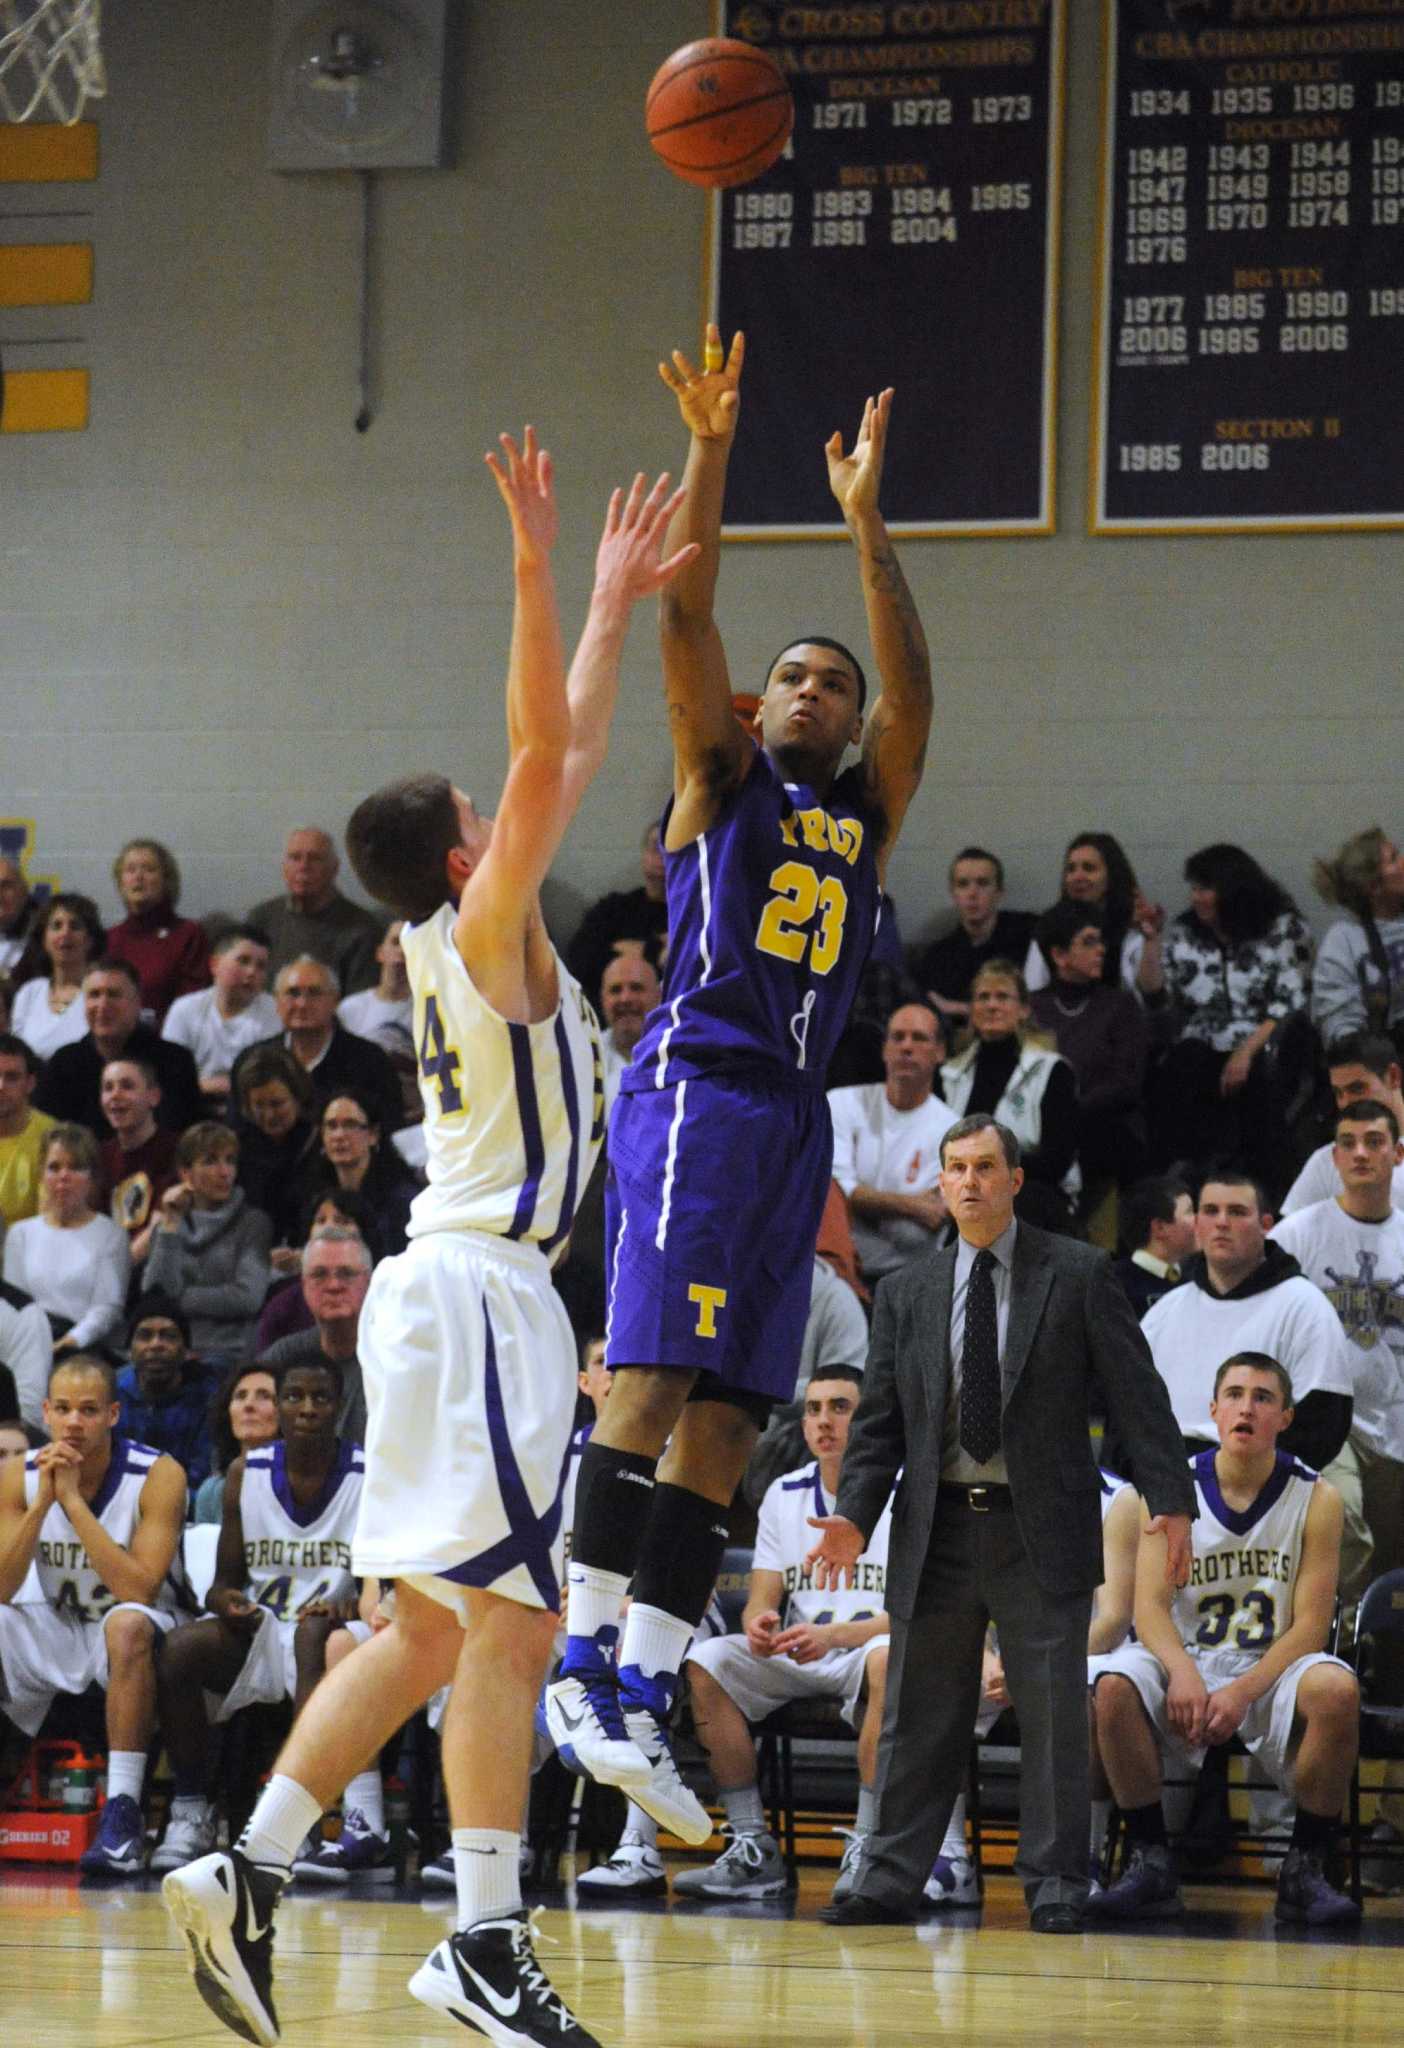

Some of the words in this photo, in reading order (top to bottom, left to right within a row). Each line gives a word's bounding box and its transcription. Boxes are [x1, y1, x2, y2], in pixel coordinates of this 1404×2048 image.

[779, 9, 884, 36] CROSS
[892, 1, 1043, 33] COUNTRY
[1232, 0, 1404, 19] FOOTBA
[803, 40, 1034, 72] CHAMPIONSHIPS
[1135, 33, 1192, 58] CBA
[1198, 24, 1404, 55] CHAMPIONSHI
[1225, 61, 1340, 82] CATHOLIC
[829, 77, 941, 98] DIOCESAN
[1130, 90, 1191, 117] 1934
[1212, 86, 1273, 115] 1935
[1293, 83, 1355, 112] 1936
[1375, 80, 1404, 108] 19
[813, 103, 867, 129] 1971
[892, 99, 952, 127] 1972
[972, 96, 1031, 124] 1973
[1226, 119, 1341, 140] DIOCESAN
[1128, 147, 1188, 175] 1942
[1208, 144, 1270, 172] 1943
[1290, 141, 1351, 168] 1944
[839, 165, 878, 186] BIG
[885, 163, 928, 185] TEN
[1128, 176, 1187, 204] 1947
[1207, 174, 1269, 202] 1949
[1290, 170, 1350, 198] 1958
[812, 219, 866, 247] 1991
[891, 217, 957, 244] 2004
[1127, 206, 1187, 234] 1969
[1206, 204, 1268, 231] 1970
[1289, 200, 1349, 228] 1974
[1126, 236, 1187, 264] 1976
[1233, 269, 1273, 289] BIG
[1280, 267, 1323, 287] TEN
[1123, 296, 1185, 324] 1977
[1120, 326, 1188, 353] 2006
[1280, 324, 1349, 352] 2006
[1215, 419, 1313, 440] SECTION
[1120, 444, 1182, 472] 1985
[1201, 443, 1270, 471] 2006
[755, 861, 848, 976] 23
[688, 1282, 727, 1339] T
[1175, 1550, 1291, 1590] ROTHERS
[1197, 1590, 1275, 1648] 33
